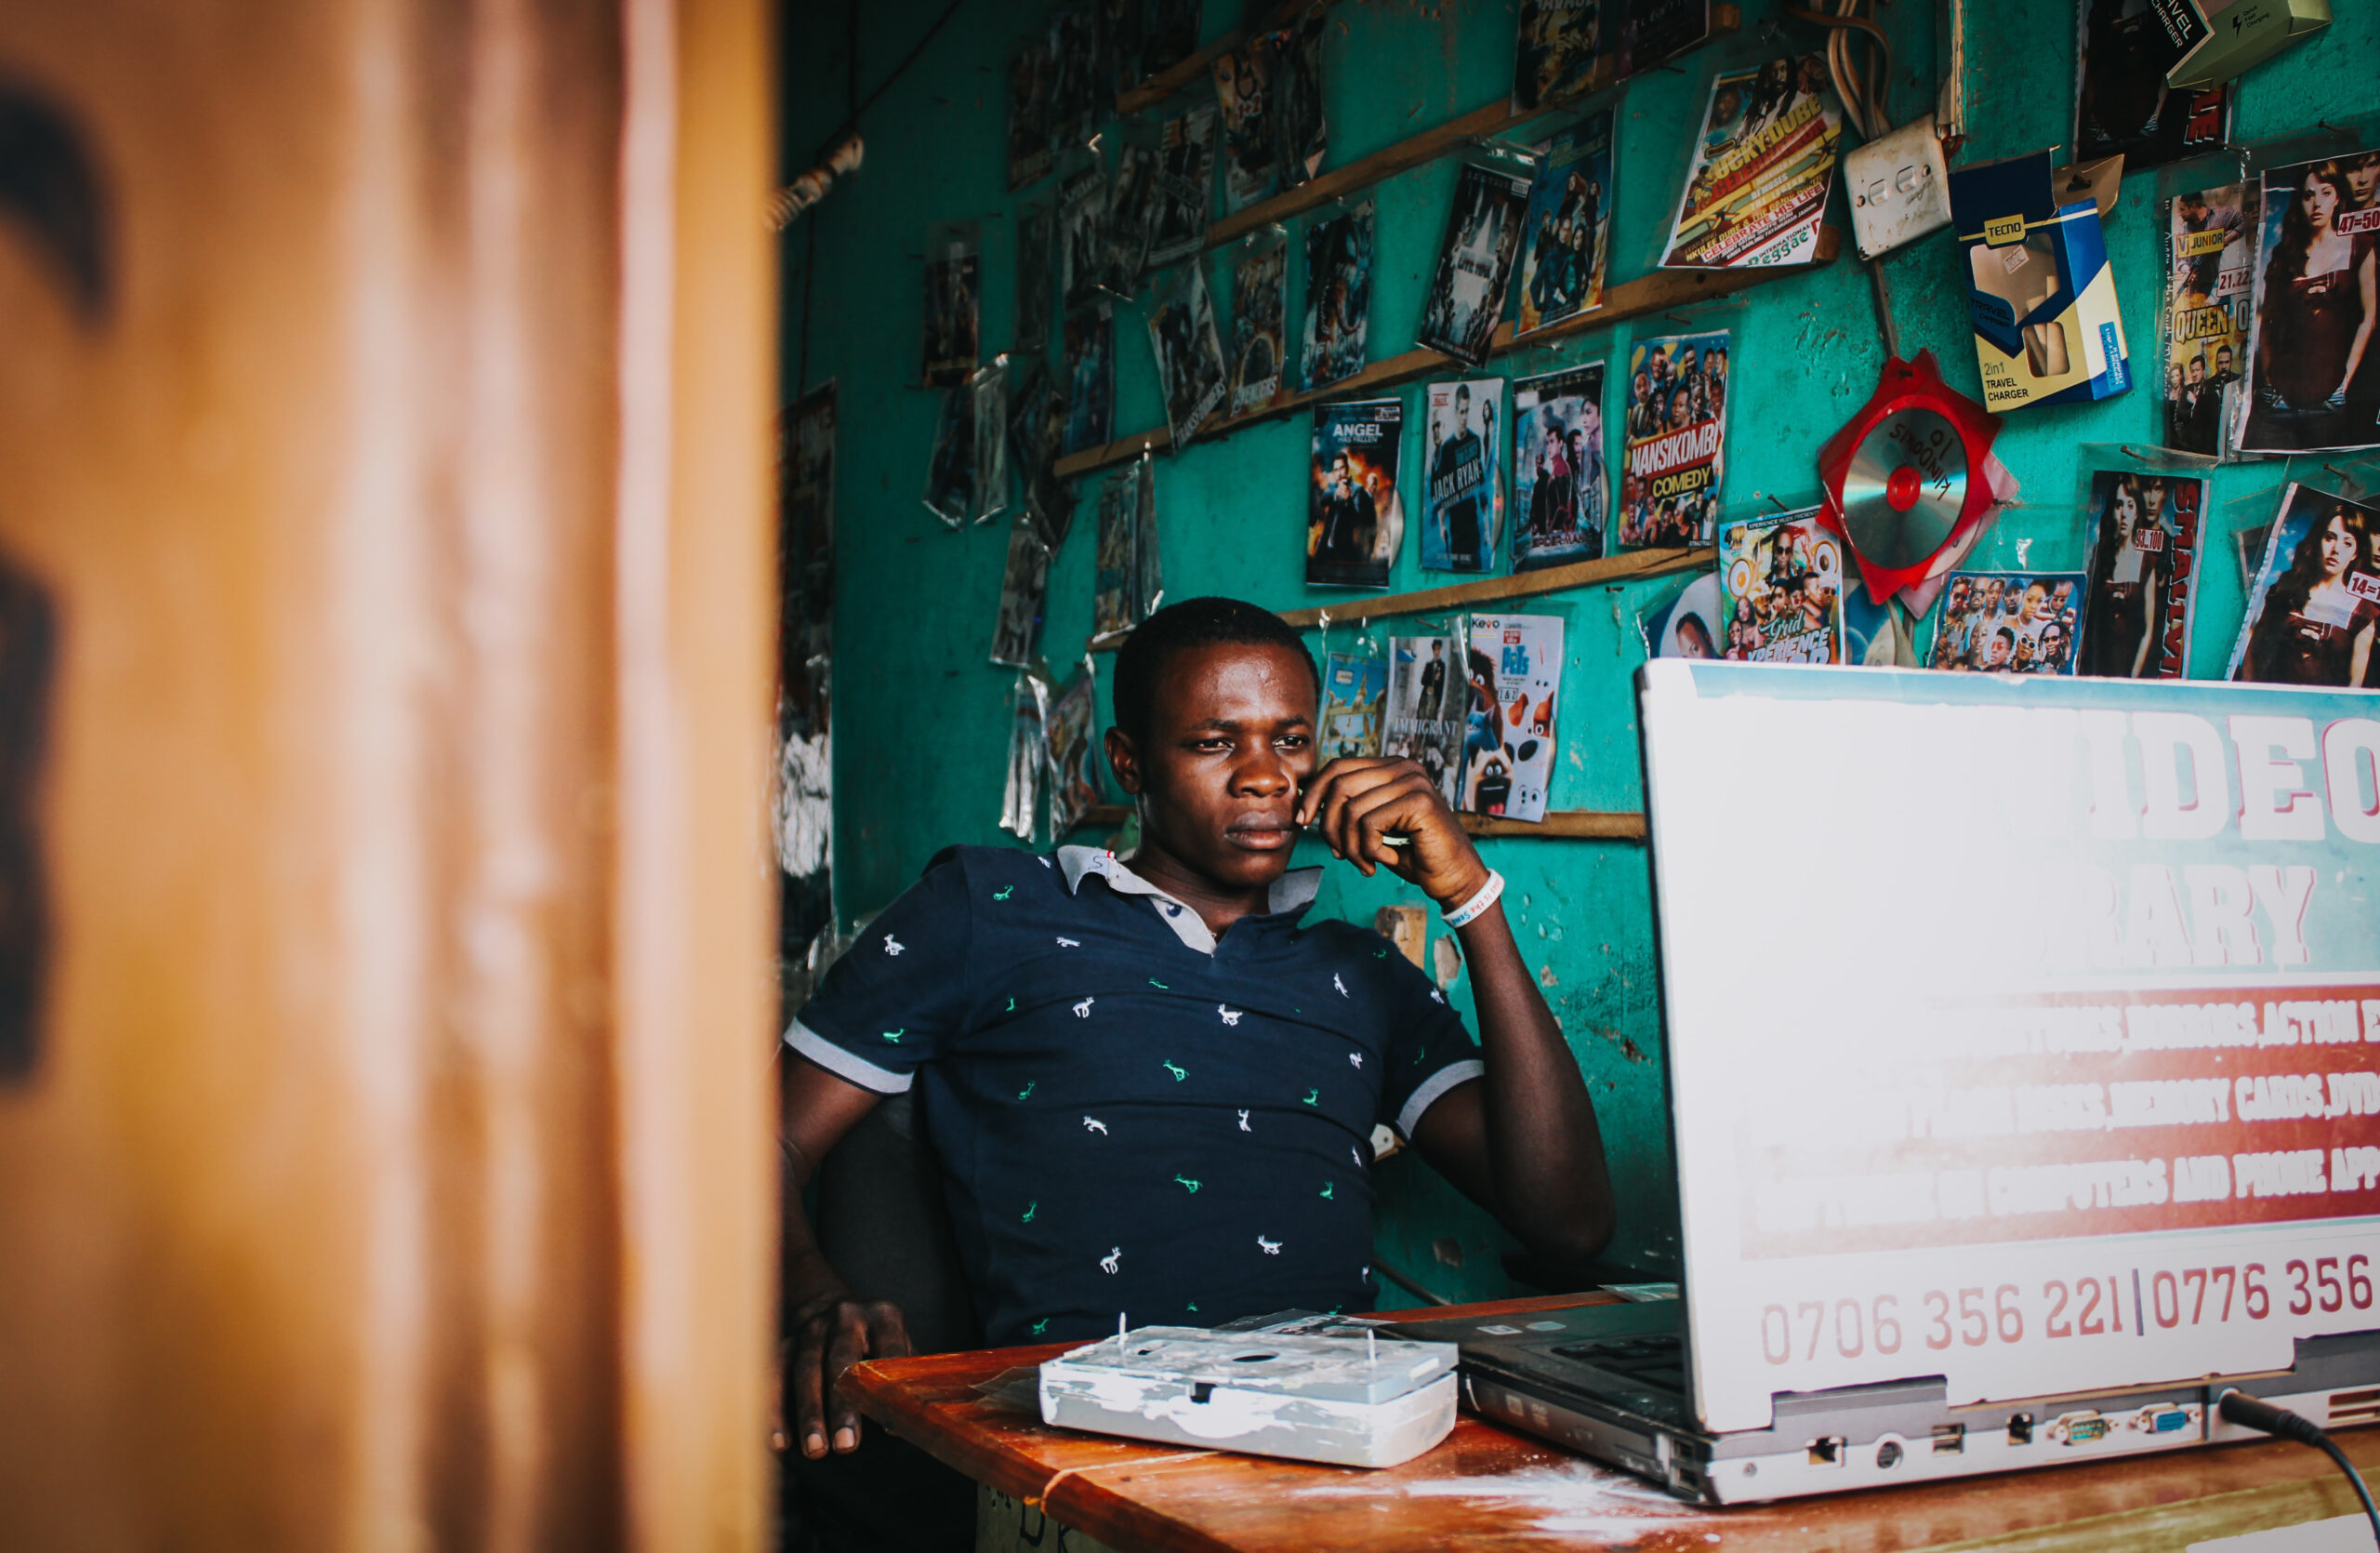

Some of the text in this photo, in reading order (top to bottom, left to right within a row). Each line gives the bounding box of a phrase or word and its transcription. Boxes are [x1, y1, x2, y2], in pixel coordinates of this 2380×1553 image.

[1765, 93, 1825, 145] DUBE
[1702, 214, 1772, 260] CELEBRATE
[1774, 201, 1794, 218] HIS
[1796, 183, 1823, 205] LIFE
[1988, 222, 2021, 237] TECNO
[1759, 224, 1810, 258] INTERNATIONAL
[2190, 232, 2223, 249] JUNIOR
[2175, 299, 2250, 344] QUEEN O
[1984, 362, 2005, 376] 2in1
[1986, 378, 2017, 390] TRAVEL
[1988, 389, 2029, 402] CHARGER
[1333, 423, 1383, 436] ANGEL
[1631, 423, 1719, 477] NANSIKOMBI
[1432, 469, 1456, 502] JACK
[1653, 466, 1712, 498] COMEDY
[1473, 618, 1500, 629] Kevo
[1762, 1294, 1903, 1365] 0706
[1924, 1284, 2025, 1350] 356
[2286, 1253, 2373, 1316] 356
